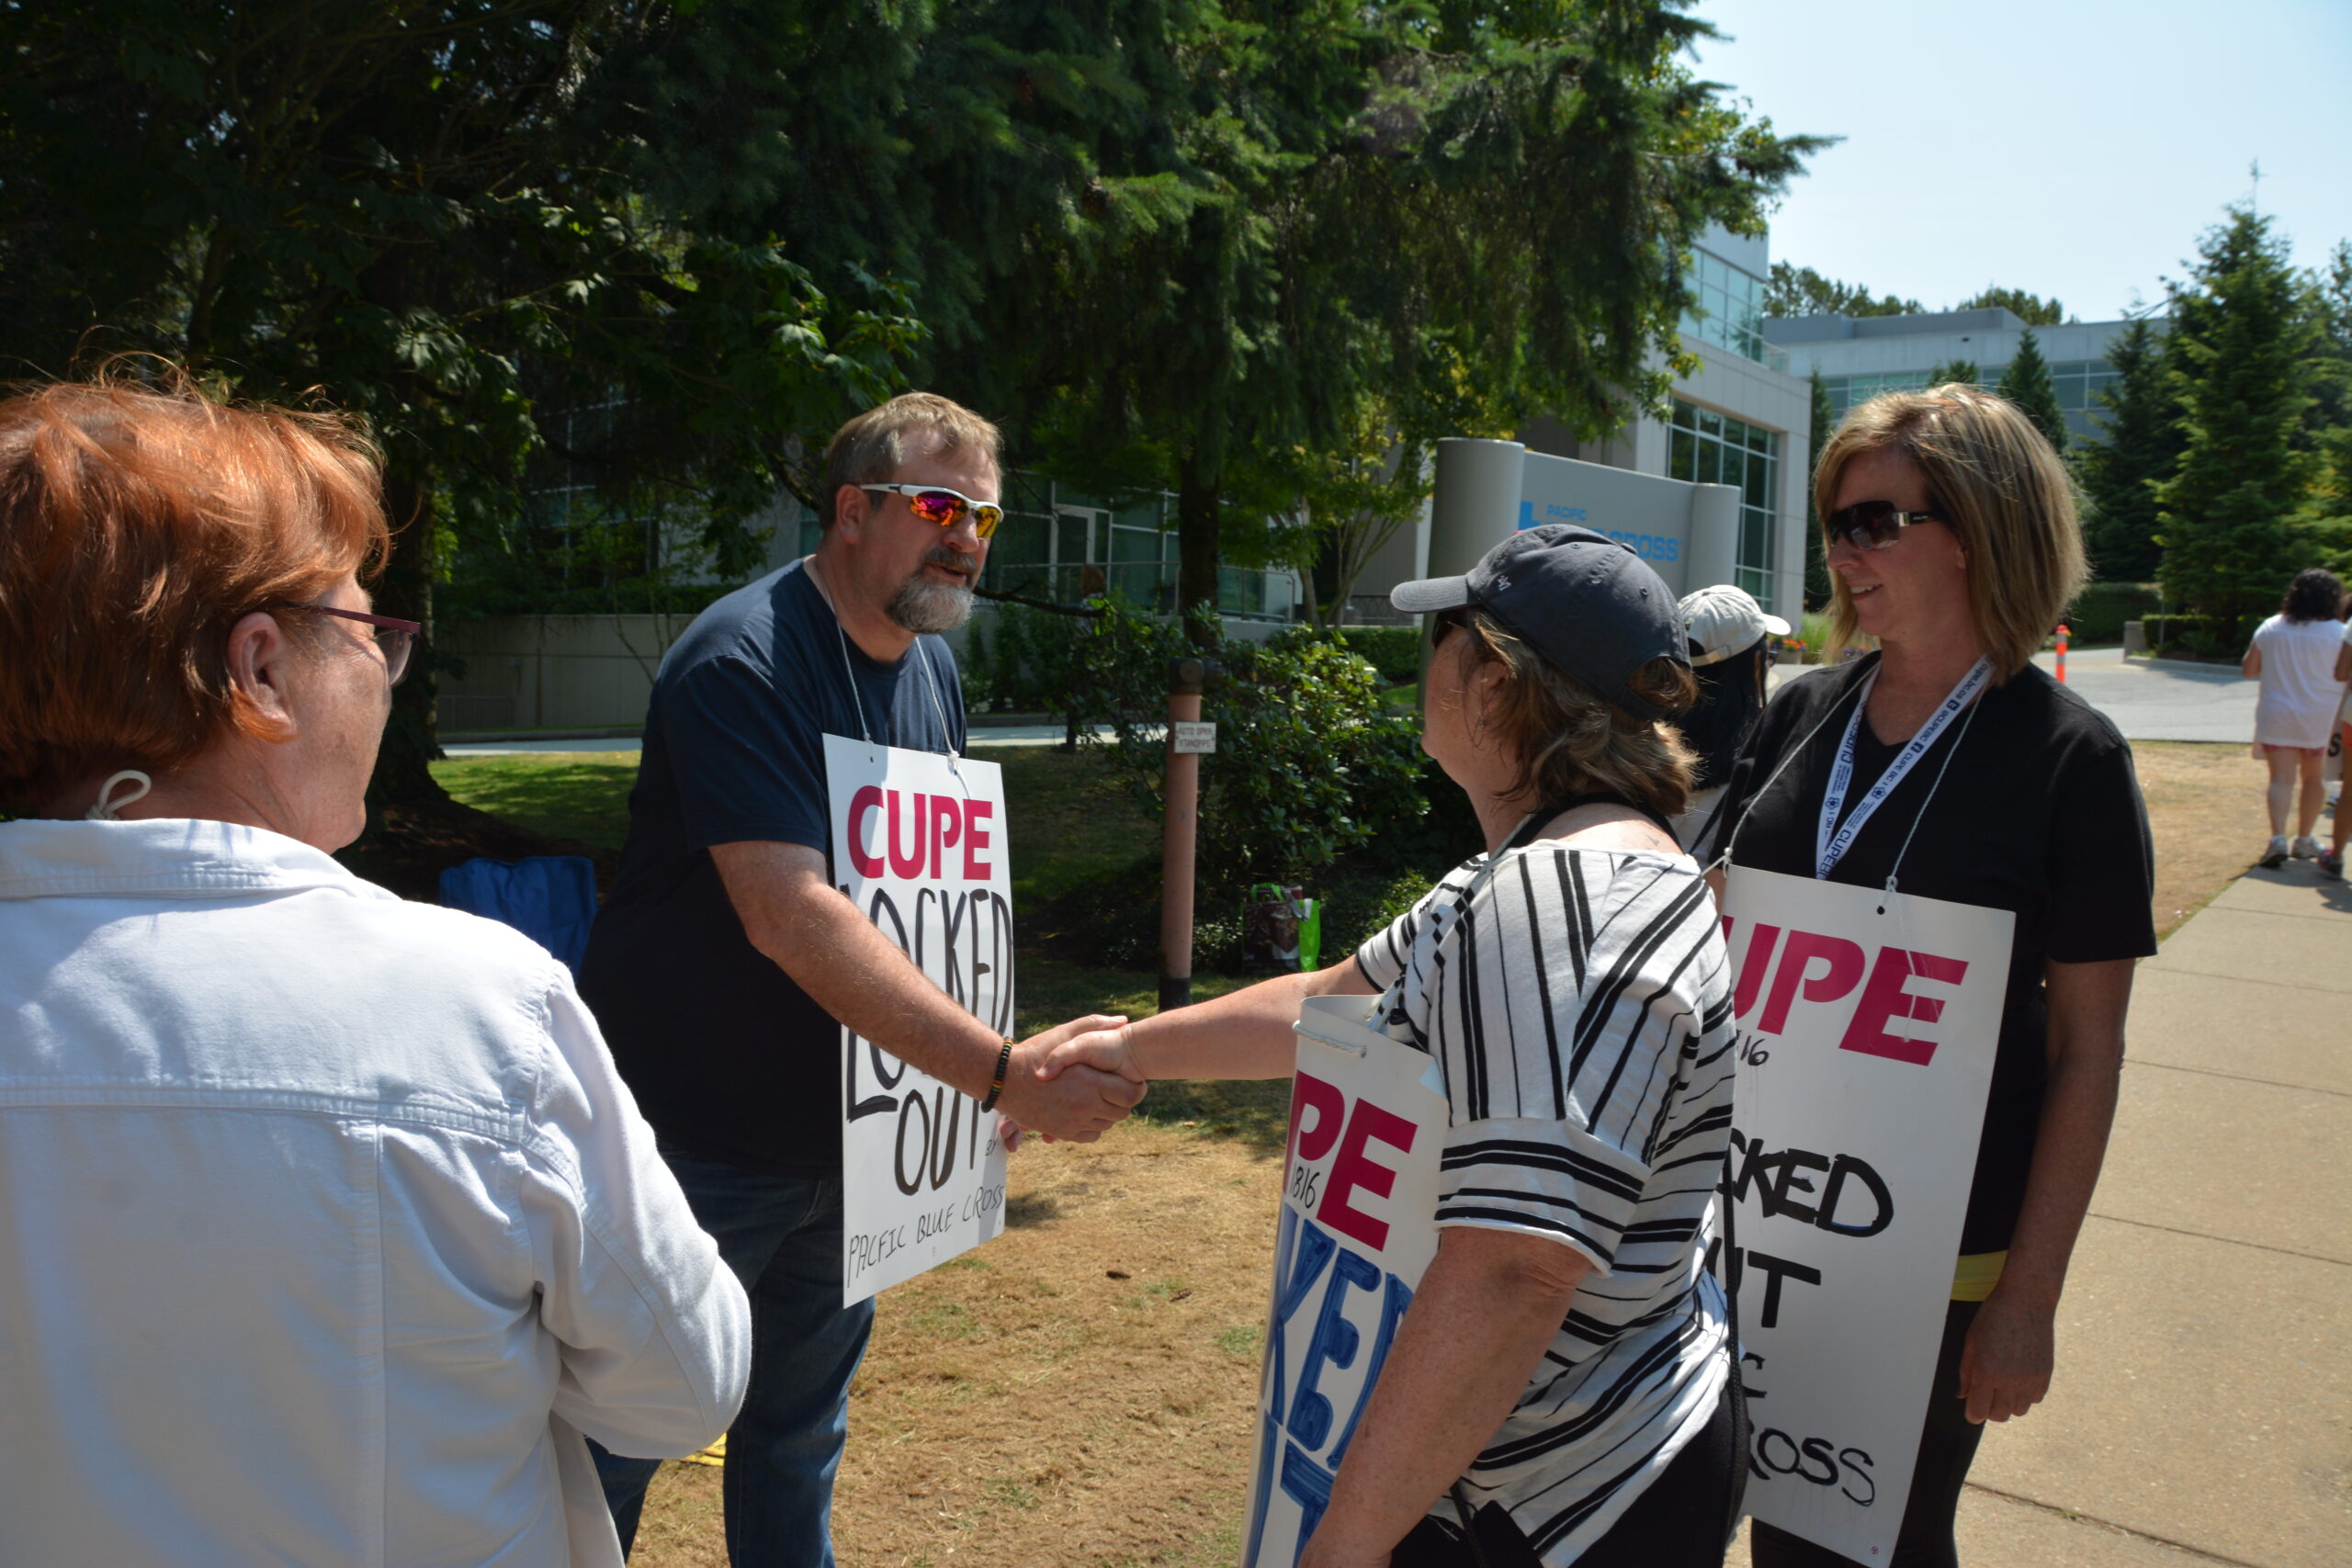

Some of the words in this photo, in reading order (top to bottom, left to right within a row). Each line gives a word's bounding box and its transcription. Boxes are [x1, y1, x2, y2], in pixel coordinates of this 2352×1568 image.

[847, 784, 992, 881] CUPE
[917, 1202, 956, 1245] BLUE
[962, 1183, 1004, 1222] CROSS
